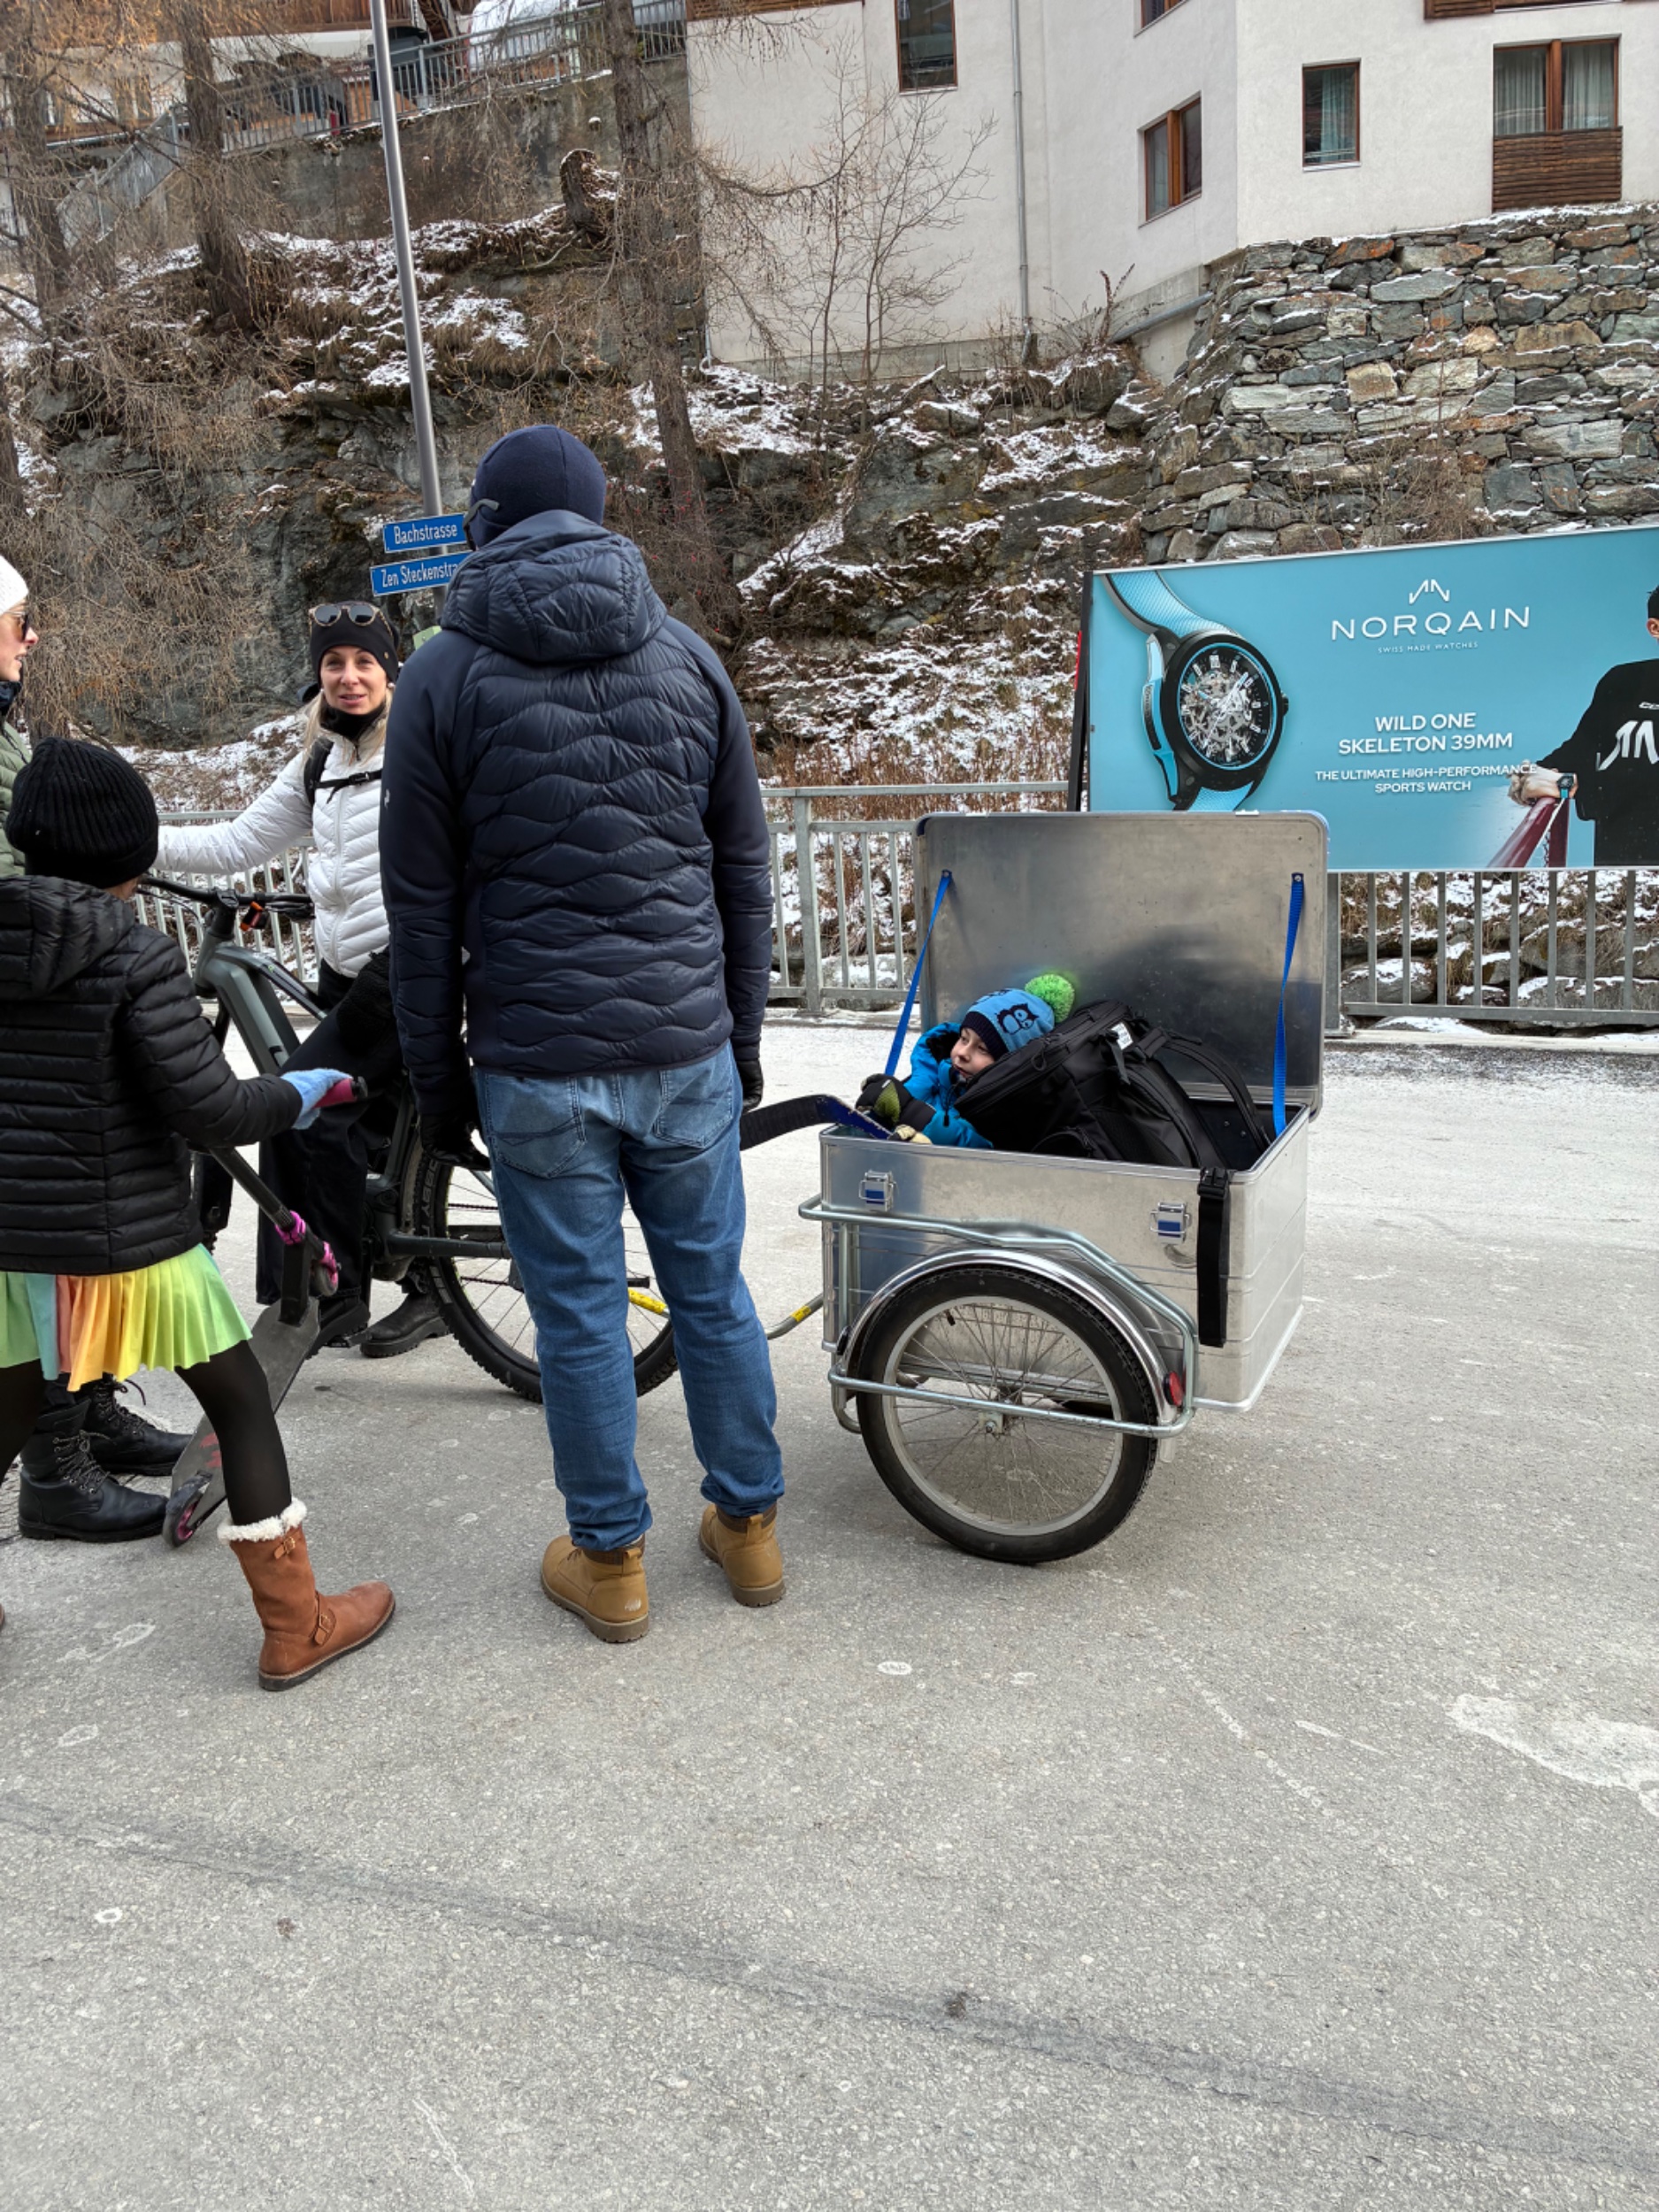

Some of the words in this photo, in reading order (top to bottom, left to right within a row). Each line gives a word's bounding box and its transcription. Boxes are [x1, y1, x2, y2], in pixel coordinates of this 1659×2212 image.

[393, 523, 458, 544] Bachstrasse
[381, 569, 399, 588] Zen
[401, 562, 458, 585] Steckenstra
[1332, 606, 1530, 641] NORQAIN
[1378, 646, 1404, 655] SWISS
[1407, 643, 1431, 652] MADE
[1434, 641, 1479, 650] WATCHES
[1374, 714, 1427, 733] WILD
[1430, 711, 1477, 730] ONE
[1338, 734, 1447, 756] SKELETON
[1449, 732, 1514, 751] 39MM
[1315, 770, 1339, 781] THE
[1340, 768, 1401, 780] ULTIMATE
[1402, 764, 1538, 780] HIGH-PERFORMANCE
[1374, 782, 1425, 794] SPORTS
[1427, 780, 1471, 792] WATCH
